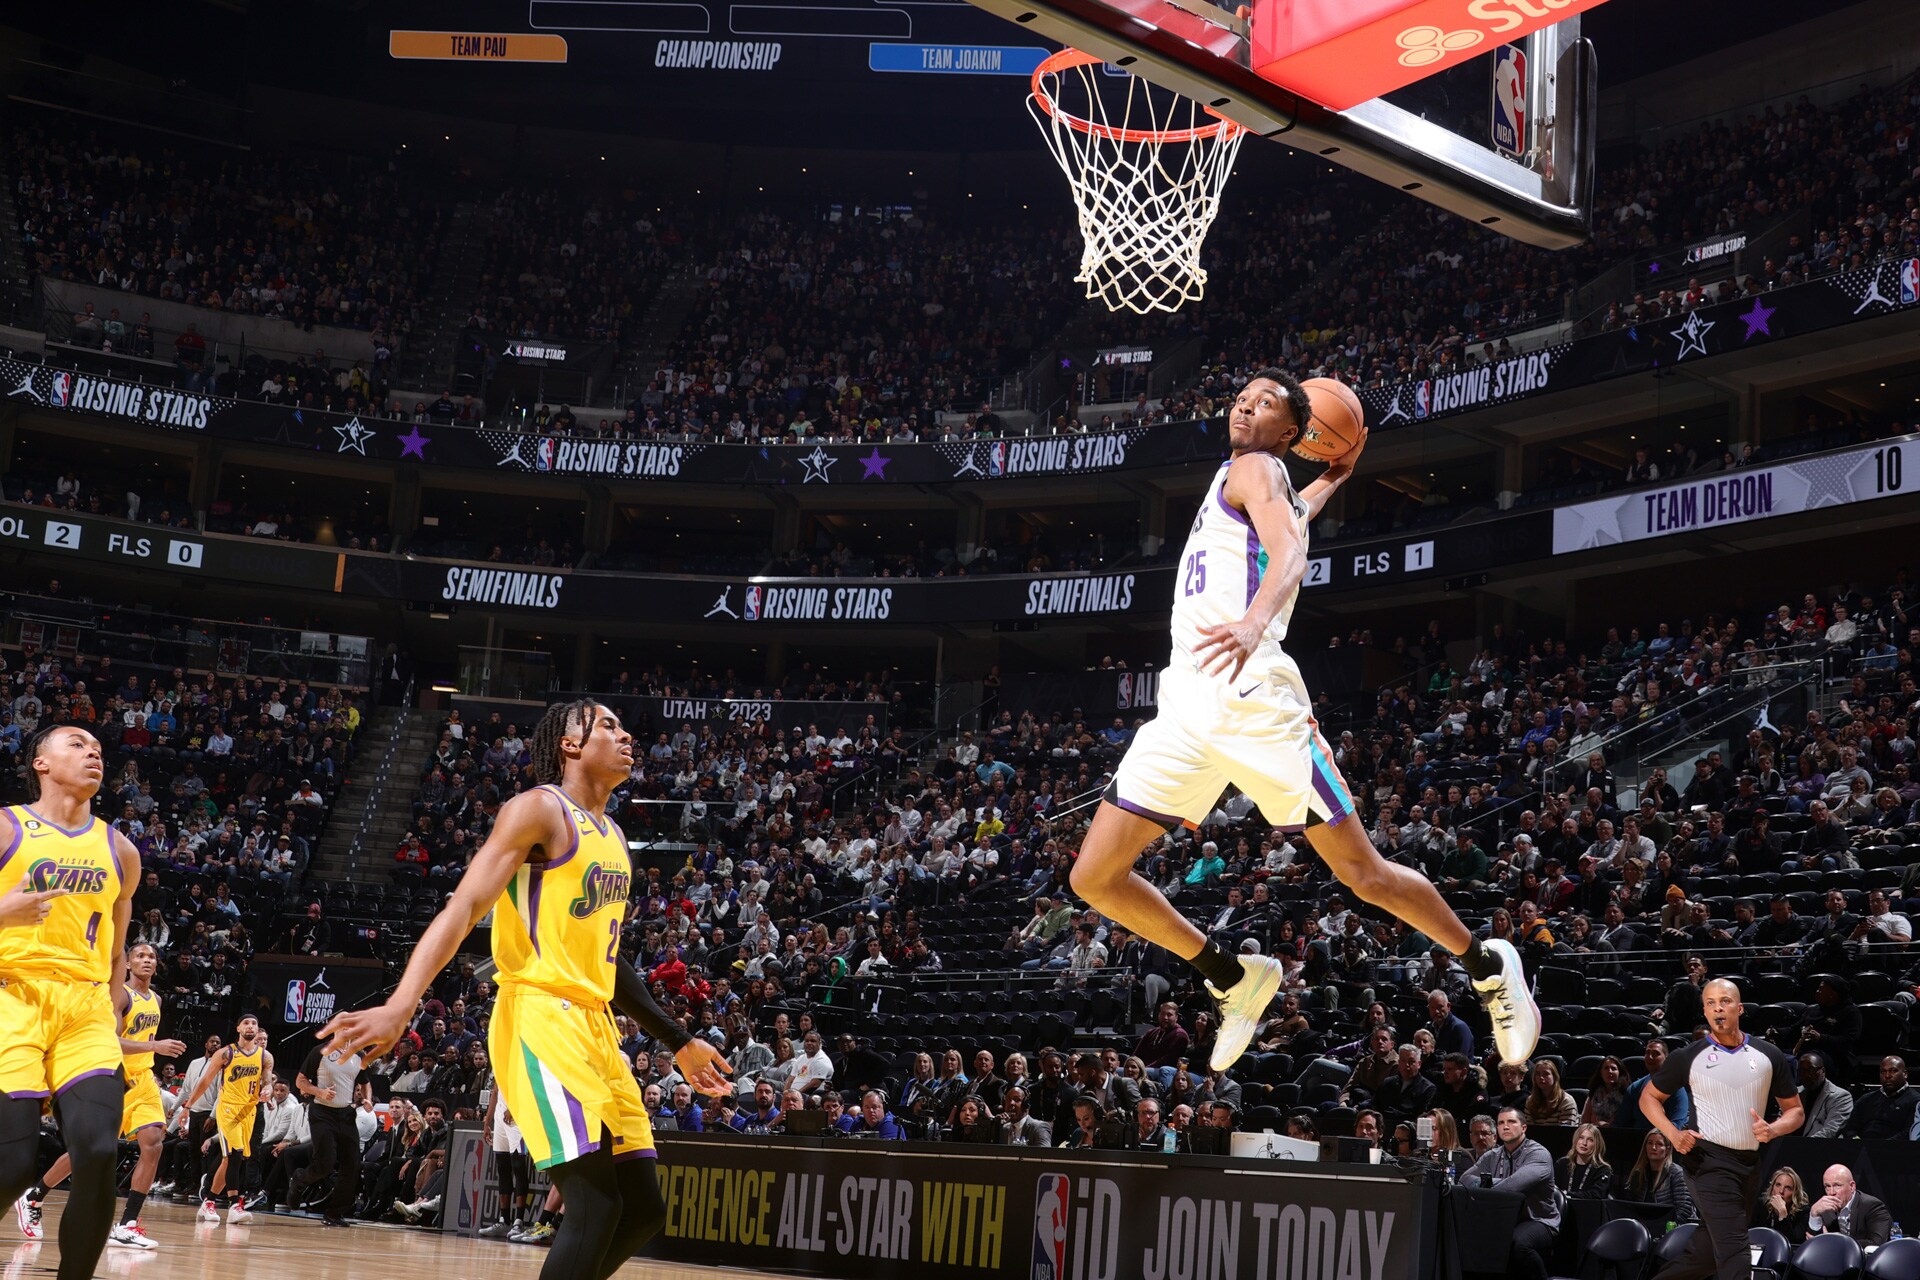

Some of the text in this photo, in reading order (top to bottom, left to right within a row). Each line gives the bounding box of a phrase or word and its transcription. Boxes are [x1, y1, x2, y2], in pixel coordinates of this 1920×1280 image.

[451, 36, 507, 57] TEAM PAU
[654, 39, 782, 71] CHAMPIONSHIP
[922, 48, 1002, 71] TEAM JOAKIM
[1496, 122, 1513, 146] NBA
[1701, 241, 1724, 260] RISING
[522, 346, 567, 361] RISING STARS
[1132, 350, 1153, 363] STARS
[1432, 352, 1550, 413] RISING STARS
[71, 378, 210, 430] RISING STARS
[555, 441, 683, 476] RISING STARS
[1007, 434, 1127, 473] RISING STARS
[1875, 446, 1902, 493] 10
[1645, 472, 1773, 533] TEAM DERON
[0, 516, 30, 540] OL
[55, 526, 69, 544] 2
[108, 533, 152, 558] FLS
[178, 544, 192, 563] 0
[1185, 550, 1207, 597] 25
[1311, 562, 1322, 581] 2
[1353, 551, 1391, 577] FLS
[1415, 547, 1423, 566] 1
[442, 566, 563, 609] SEMIFINALS
[763, 588, 893, 619] RISING STARS
[1024, 574, 1135, 615] SEMIFINALS
[663, 700, 772, 721] UTAH 2023
[24, 858, 108, 894] STARS
[59, 857, 95, 866] RISING
[569, 862, 630, 919] STARS
[86, 911, 103, 951] 4
[606, 918, 623, 965] 2
[306, 992, 336, 1009] RISING
[128, 1012, 160, 1035] STARS
[228, 1065, 260, 1082] STARS
[248, 1081, 257, 1095] 15
[776, 1172, 914, 1260] ALL-STAR
[922, 1181, 1006, 1269] WITH
[1143, 1196, 1241, 1280] JOIN
[1253, 1202, 1396, 1280] TODAY
[1035, 1263, 1051, 1280] NBA
